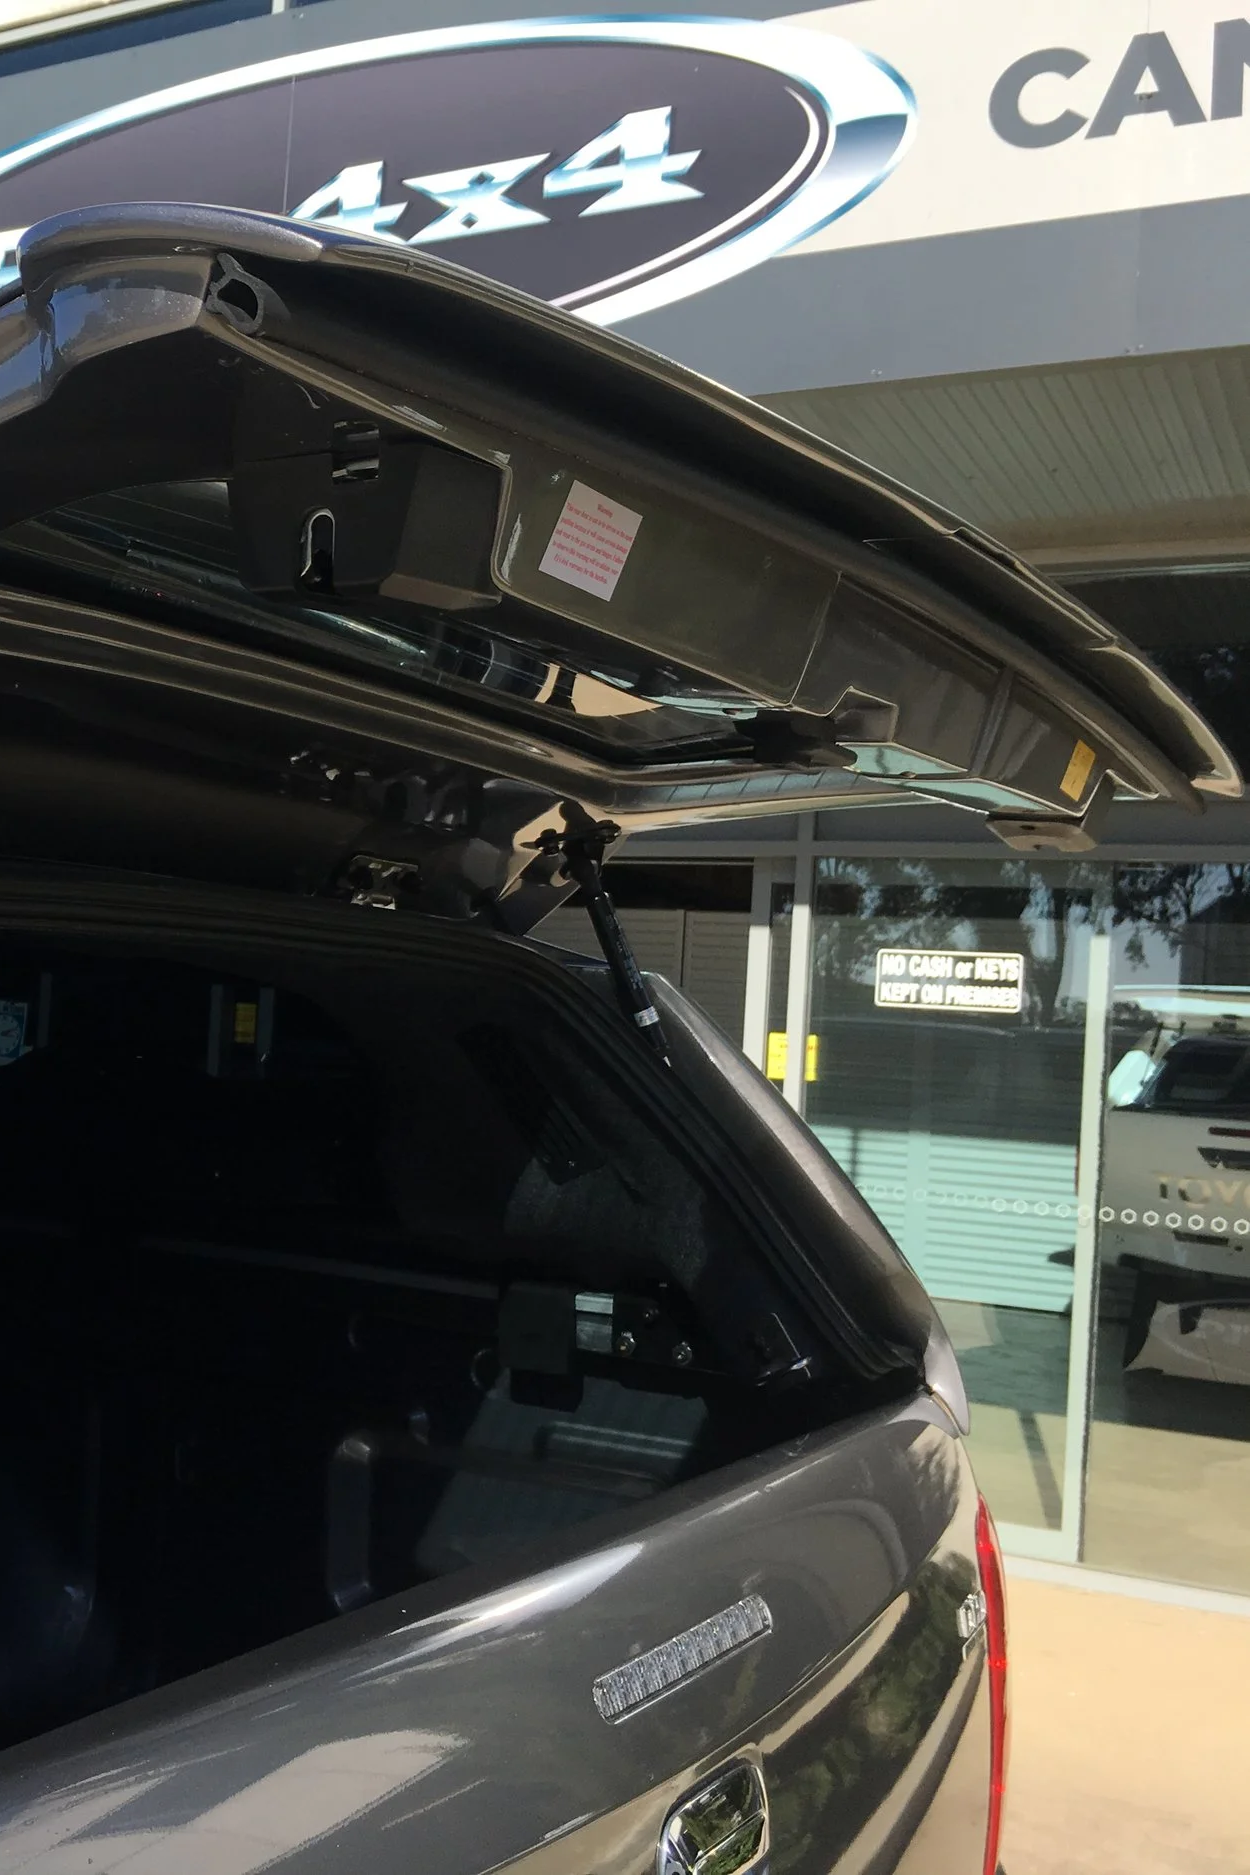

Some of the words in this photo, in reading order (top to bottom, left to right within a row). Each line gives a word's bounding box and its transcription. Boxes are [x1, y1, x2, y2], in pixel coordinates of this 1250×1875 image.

[881, 953, 906, 976] NO
[909, 955, 954, 979] CASH
[954, 961, 974, 979] or
[974, 957, 1019, 981] KEYS
[880, 982, 920, 1003] KEPT
[921, 983, 944, 1004] ON
[1151, 1170, 1250, 1209] TOY
